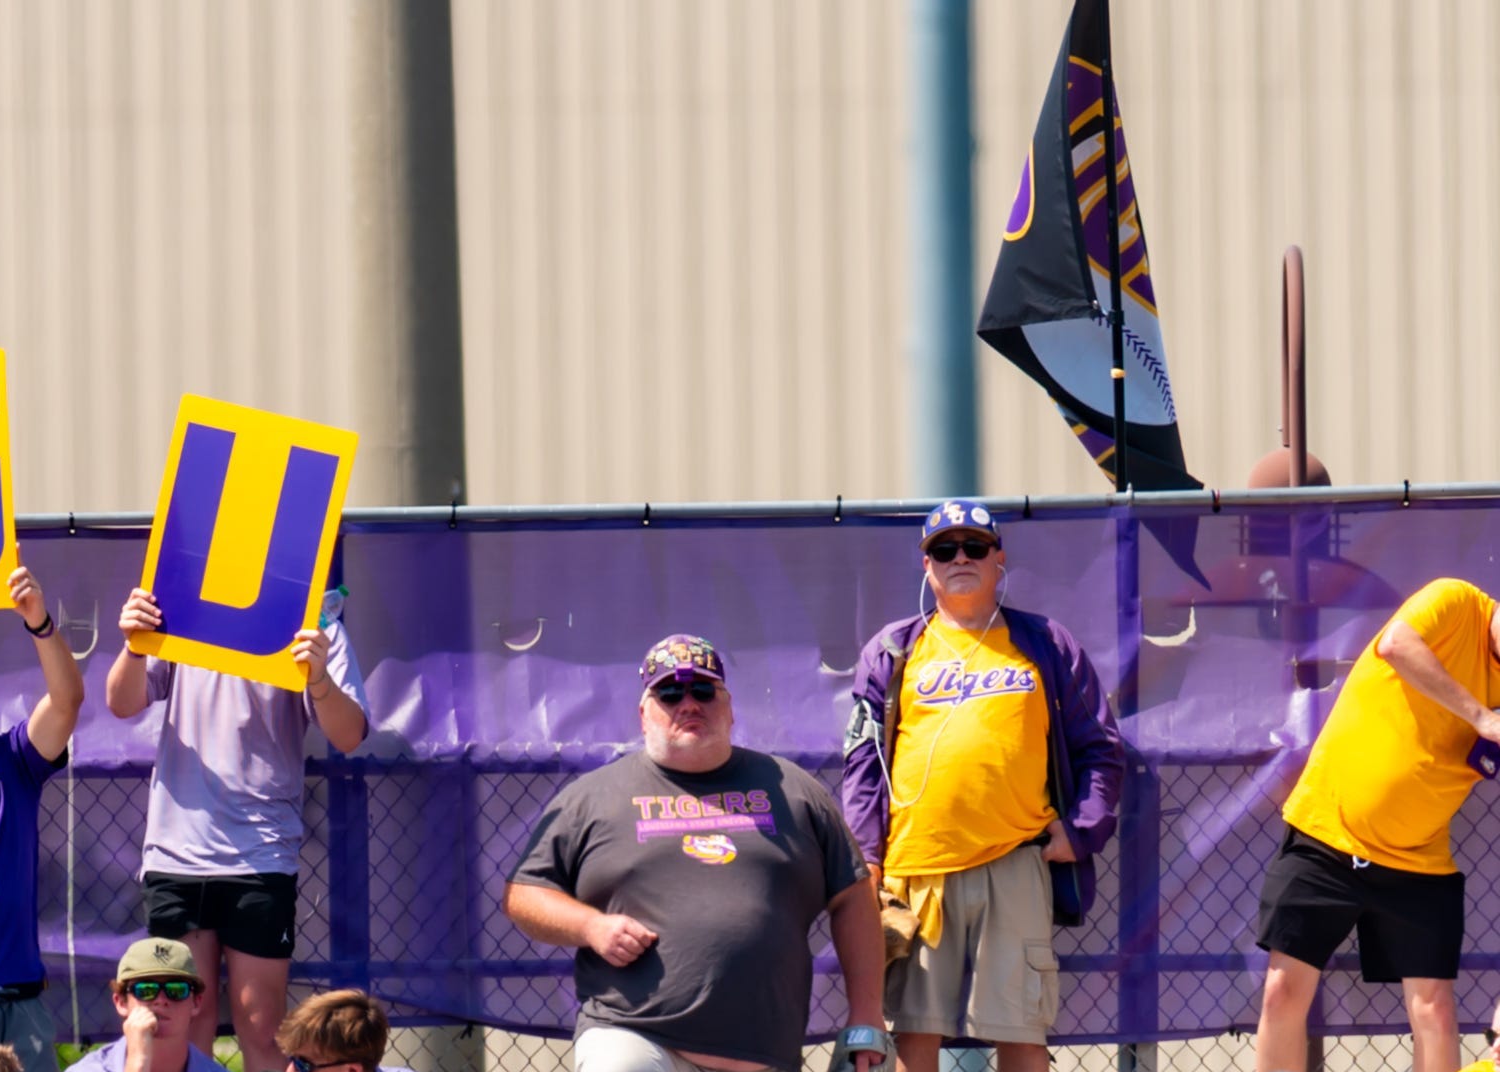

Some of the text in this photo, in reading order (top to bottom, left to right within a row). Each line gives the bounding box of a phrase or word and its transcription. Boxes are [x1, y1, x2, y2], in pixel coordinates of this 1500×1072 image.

[153, 422, 340, 656] U
[916, 660, 1036, 704] Tigers
[633, 789, 771, 819] TIGERS
